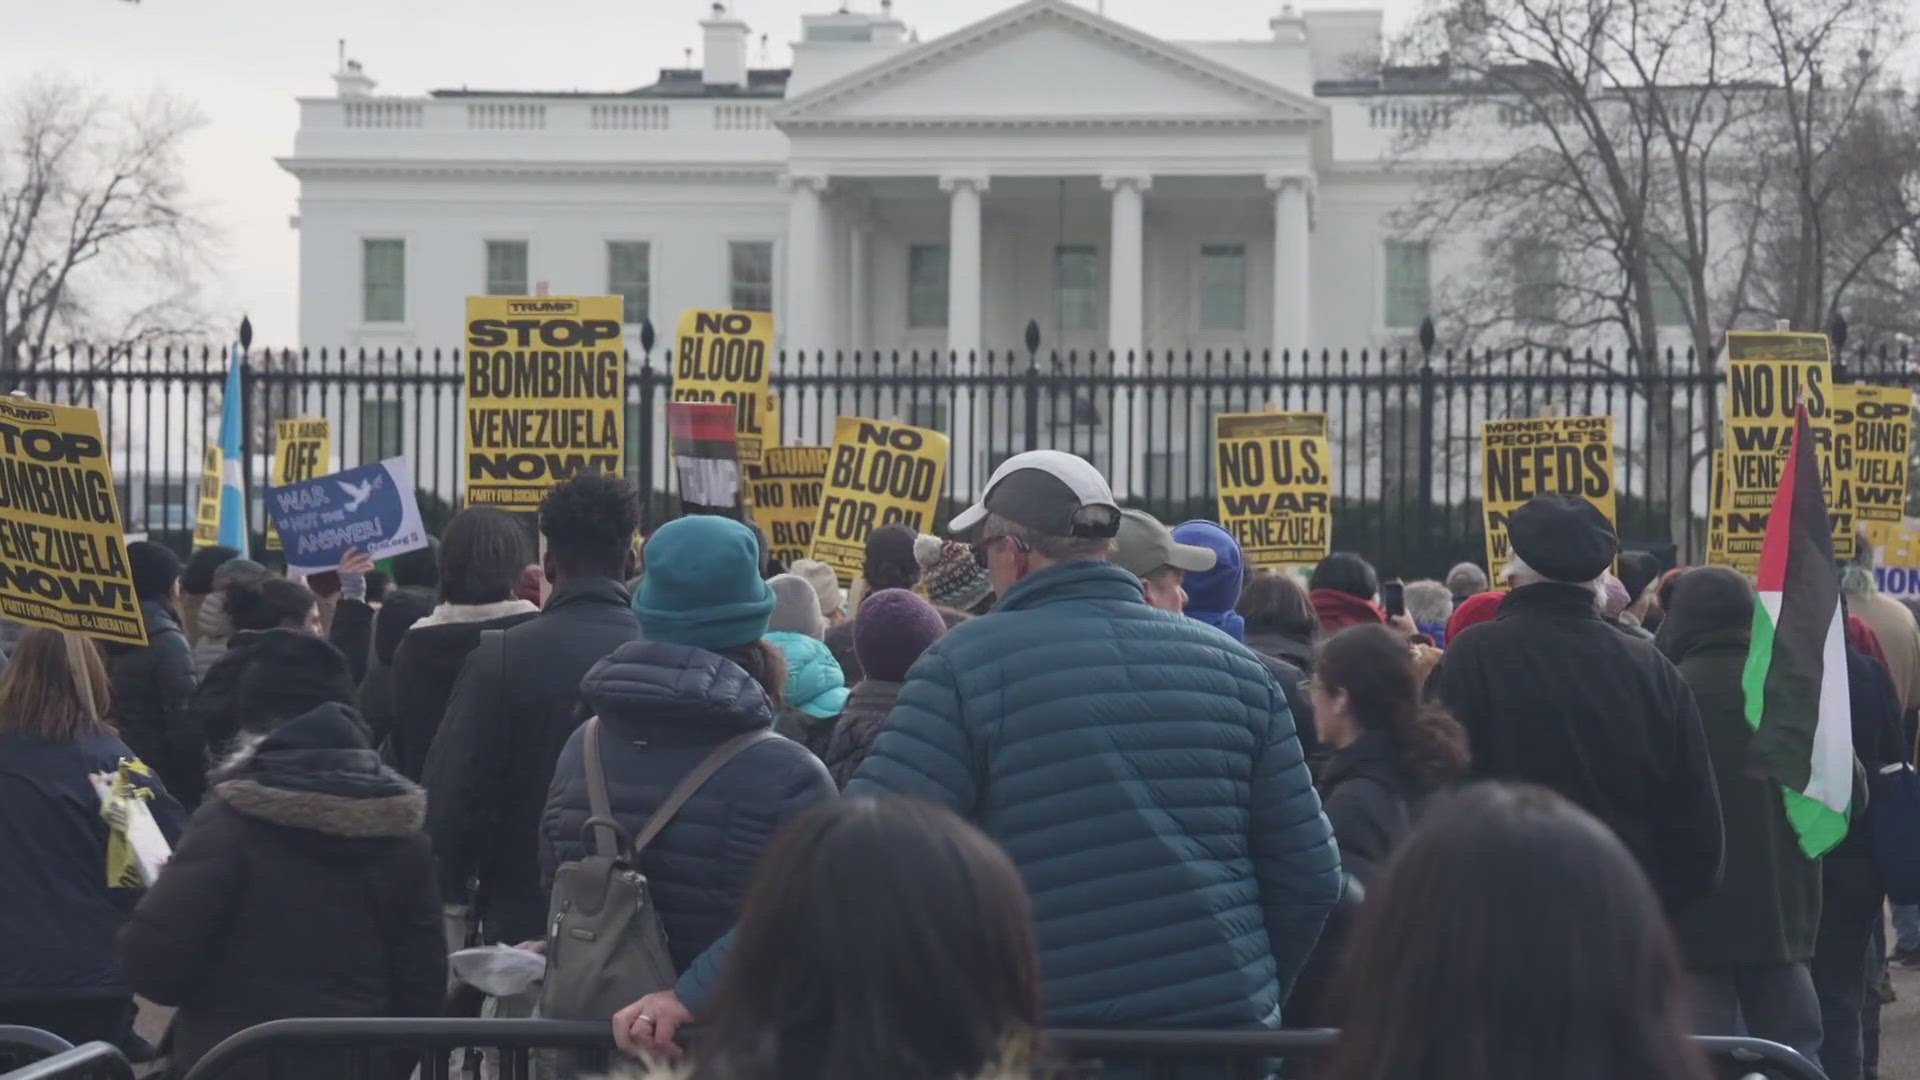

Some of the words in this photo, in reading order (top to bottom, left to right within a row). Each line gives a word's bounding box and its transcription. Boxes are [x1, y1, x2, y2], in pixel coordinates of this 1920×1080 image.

[510, 302, 573, 313] TRUMP
[696, 313, 751, 334] NO
[468, 319, 620, 347] STOP
[469, 351, 618, 399] BOMBING
[679, 337, 764, 383] BLOOD
[1731, 364, 1774, 418] NO
[1781, 364, 1832, 418] US.
[1485, 421, 1558, 433] MONEY
[1563, 418, 1607, 431] FOR
[1855, 401, 1910, 420] OP
[0, 423, 101, 464] TOP
[469, 408, 618, 449] VENEZUELA
[858, 423, 923, 451] NO
[1486, 430, 1607, 446] PEOPLE'S
[1855, 421, 1907, 453] BING
[283, 441, 321, 482] OFF
[831, 445, 936, 502] BLOOD
[1219, 441, 1265, 488] NO
[1270, 439, 1328, 485] U.S.
[1487, 444, 1610, 502] NEEDS
[0, 457, 115, 524] OMBING
[277, 485, 330, 513] WAR
[754, 483, 784, 508] NO
[791, 482, 823, 508] MO
[1222, 492, 1328, 516] WAR
[772, 521, 816, 546] BLO
[819, 496, 876, 543] FOR
[1224, 517, 1326, 548] VENEZUELA
[0, 518, 127, 579] ENEZUELA
[0, 561, 134, 612] NOW!
[80, 614, 92, 627] &
[92, 615, 139, 636] LIBERATION
